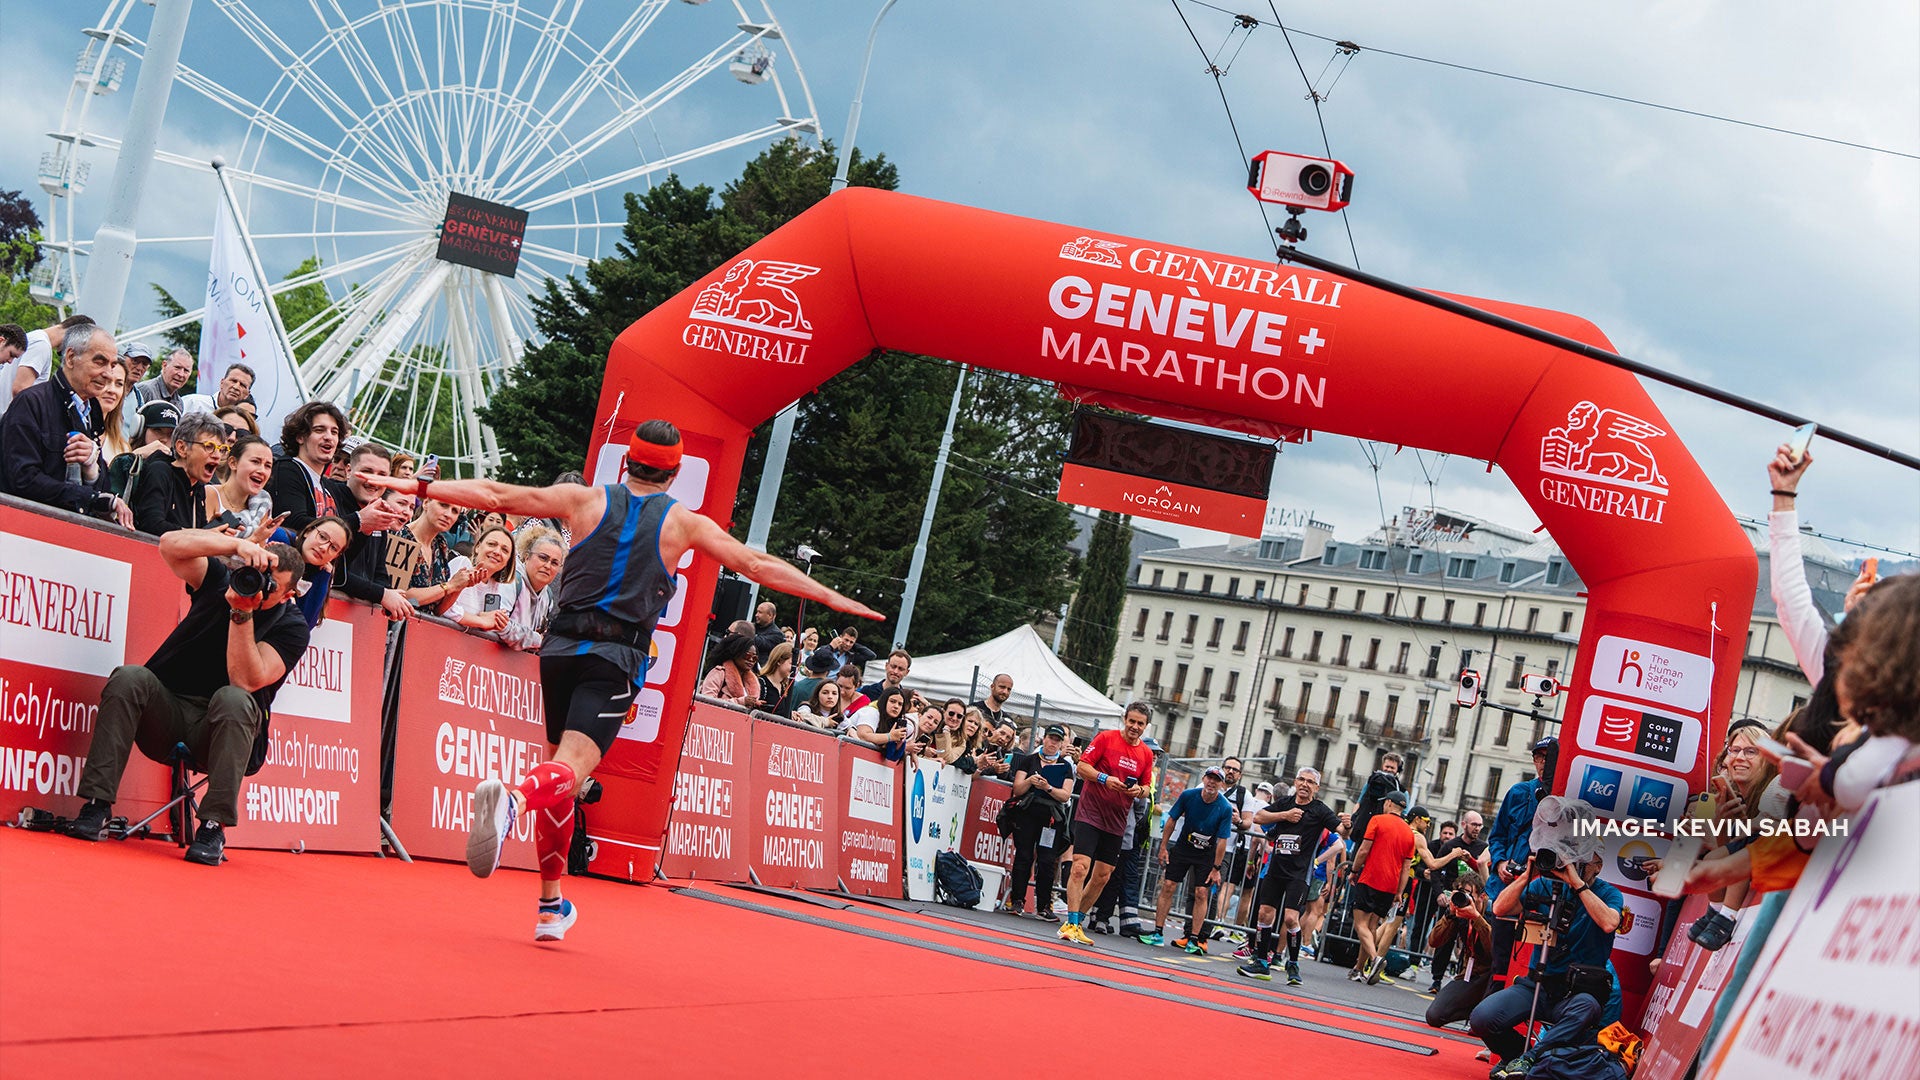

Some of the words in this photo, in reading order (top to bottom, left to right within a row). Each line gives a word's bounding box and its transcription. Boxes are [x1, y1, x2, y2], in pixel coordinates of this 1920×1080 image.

[441, 234, 520, 263] MARATHON
[444, 219, 510, 247] GENÈVE
[1128, 247, 1348, 309] GENERALI
[1048, 275, 1288, 357] GENÈVE
[682, 323, 810, 365] GENERALI
[1041, 326, 1327, 408] MARATHON
[1122, 492, 1201, 515] NORQAIN
[1539, 477, 1667, 524] GENERALI
[1648, 663, 1684, 679] Human
[1651, 653, 1670, 666] The
[466, 663, 544, 726] GENERALI
[1644, 681, 1663, 693] Net
[1646, 672, 1679, 689] Safety
[688, 722, 735, 766] GENERALI
[1646, 732, 1672, 744] RESS
[1648, 723, 1674, 734] COMP
[265, 728, 360, 784] ali.ch/running
[435, 719, 527, 787] GENÈVE
[1644, 741, 1670, 753] PORT
[781, 745, 825, 784] GENERALI
[246, 782, 340, 825] #RUNFORIT
[672, 764, 722, 816] GENÈVE
[863, 777, 891, 809] GENERALI
[1587, 780, 1616, 797] P&G
[1638, 791, 1668, 809] P&G
[765, 783, 815, 830] GENÈVE
[668, 821, 732, 860] MARATHON
[763, 835, 824, 870] MARATHON
[1282, 842, 1300, 850] 1213
[850, 858, 889, 884] #RUNFORIT
